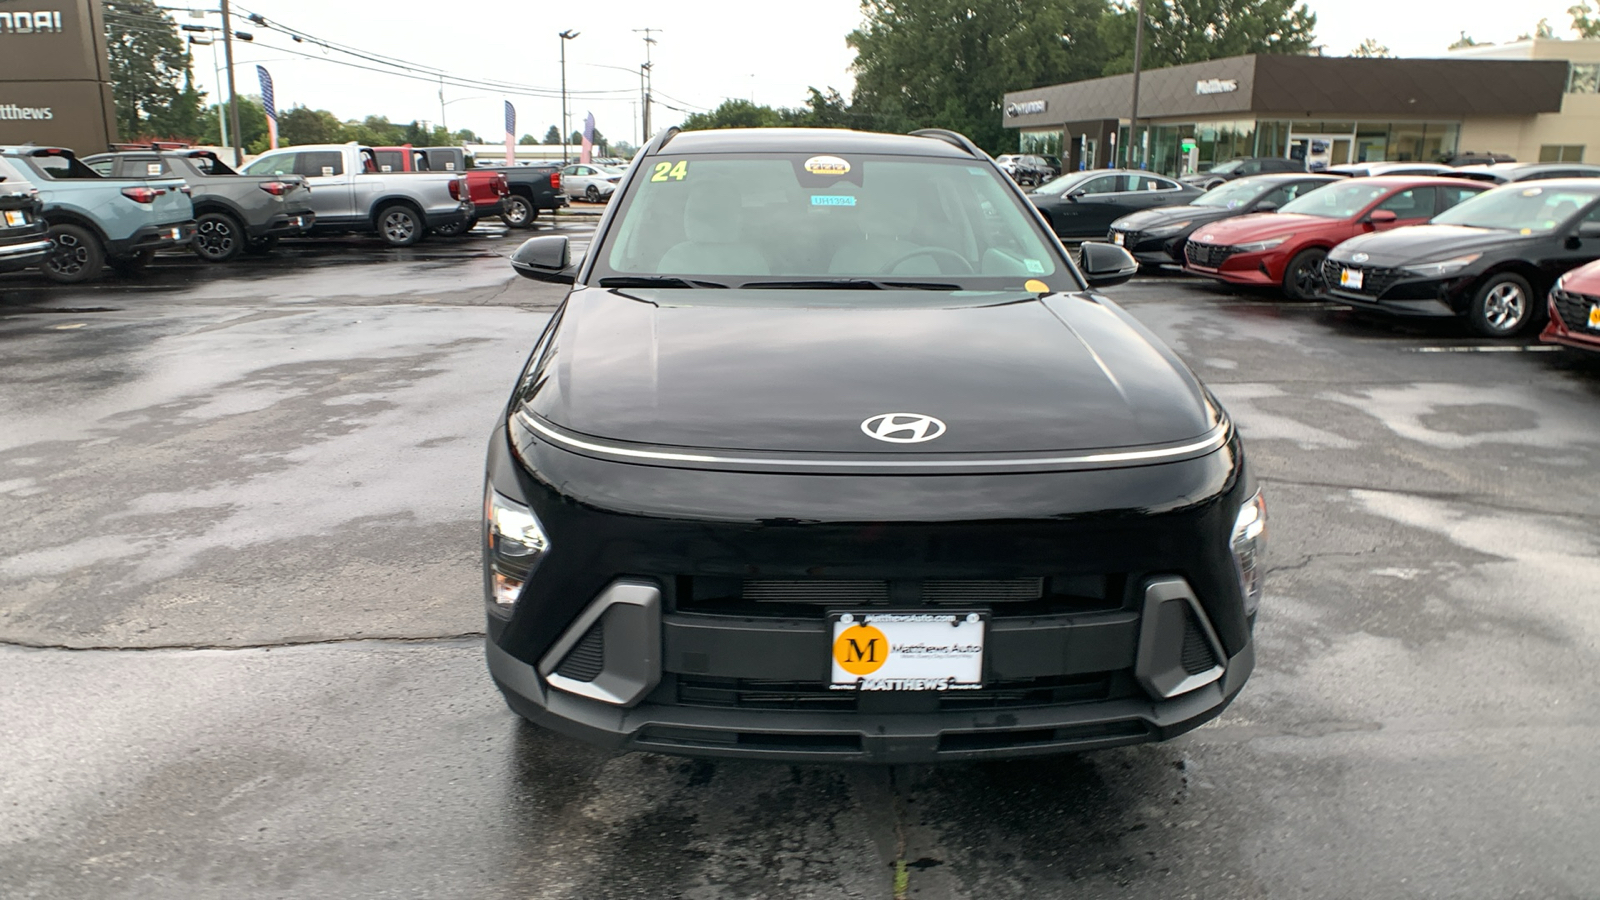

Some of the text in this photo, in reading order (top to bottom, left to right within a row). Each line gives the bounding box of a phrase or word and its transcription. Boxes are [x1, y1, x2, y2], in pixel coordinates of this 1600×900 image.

[1196, 78, 1238, 95] Matthews
[0, 103, 54, 120] tthews
[651, 160, 688, 182] 24
[814, 197, 852, 205] UH1394
[844, 638, 880, 663] M
[892, 643, 982, 654] Matthews Auto
[860, 678, 950, 691] MATTHEWS
